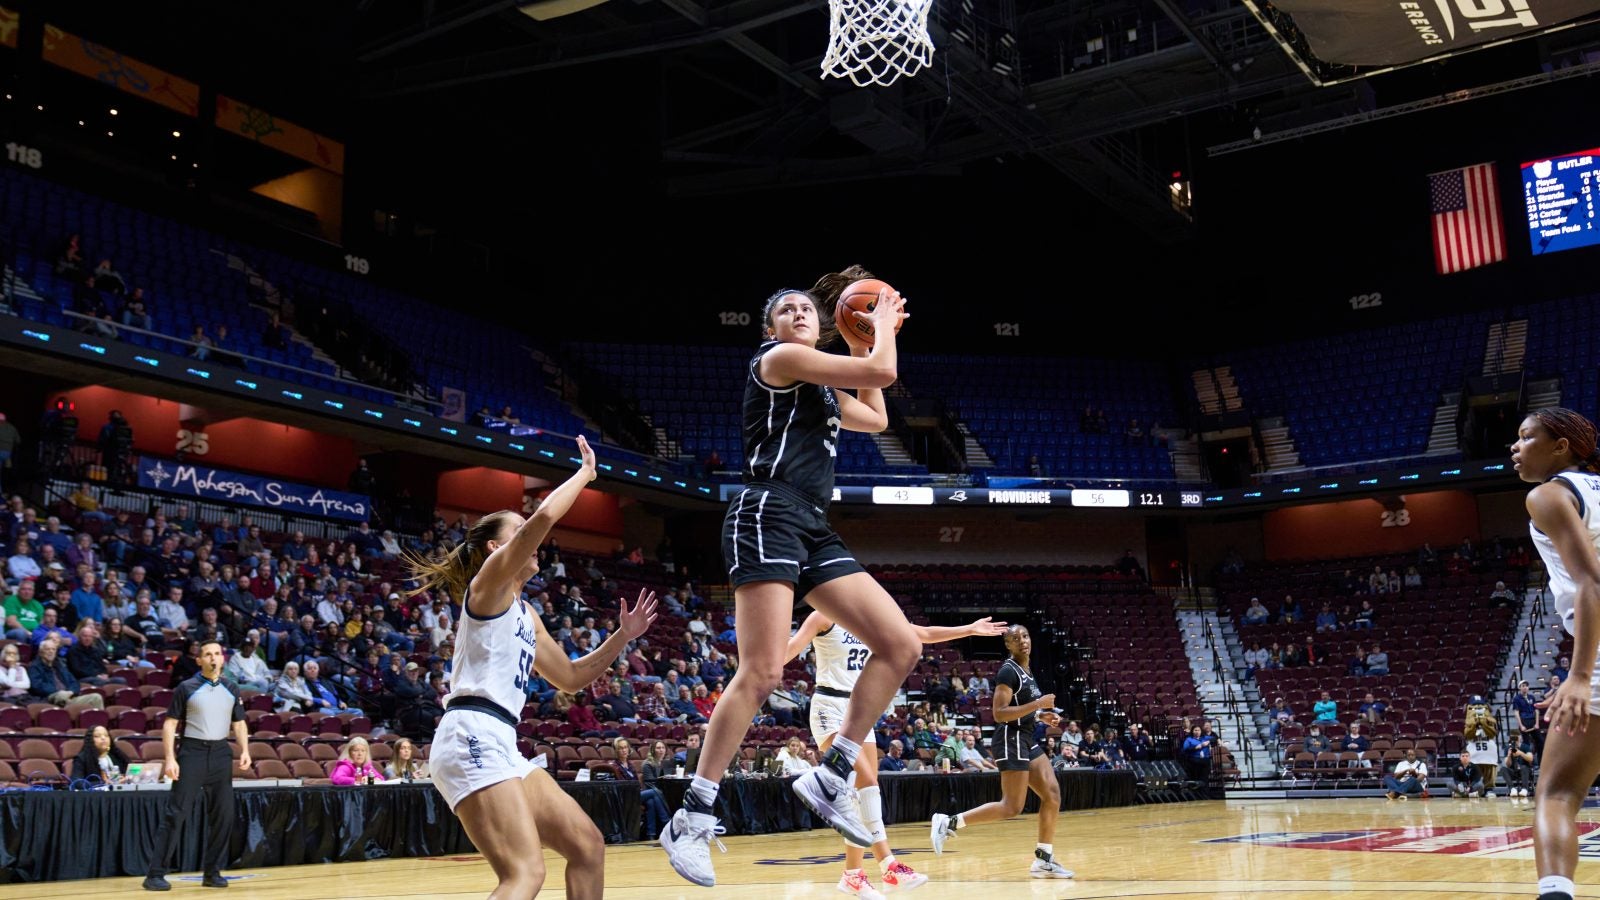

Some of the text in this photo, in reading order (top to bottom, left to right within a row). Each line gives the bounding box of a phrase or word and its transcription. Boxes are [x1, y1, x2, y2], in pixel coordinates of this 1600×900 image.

[5, 141, 43, 169] 118
[1557, 156, 1593, 170] BUTLER
[1536, 178, 1557, 187] Player
[1526, 196, 1536, 205] 21
[1528, 204, 1537, 212] 23
[1528, 202, 1593, 220] 24 Carter 6
[1530, 220, 1539, 228] 55
[1588, 210, 1594, 218] 0
[1540, 228, 1560, 237] Team
[1561, 224, 1581, 234] Fouls
[344, 254, 370, 276] 119
[1348, 291, 1384, 311] 122
[718, 312, 750, 326] 120
[993, 322, 1020, 337] 121
[176, 429, 209, 455] 25
[172, 466, 365, 516] Mohegan Sun Arena
[894, 490, 1051, 504] 43 PROVIDENCE
[1091, 494, 1104, 504] 56
[1140, 494, 1164, 506] 12.1
[1181, 495, 1200, 504] 3RD
[1381, 508, 1411, 528] 28
[939, 526, 964, 543] 27
[847, 648, 869, 670] 23
[1476, 742, 1488, 751] 55
